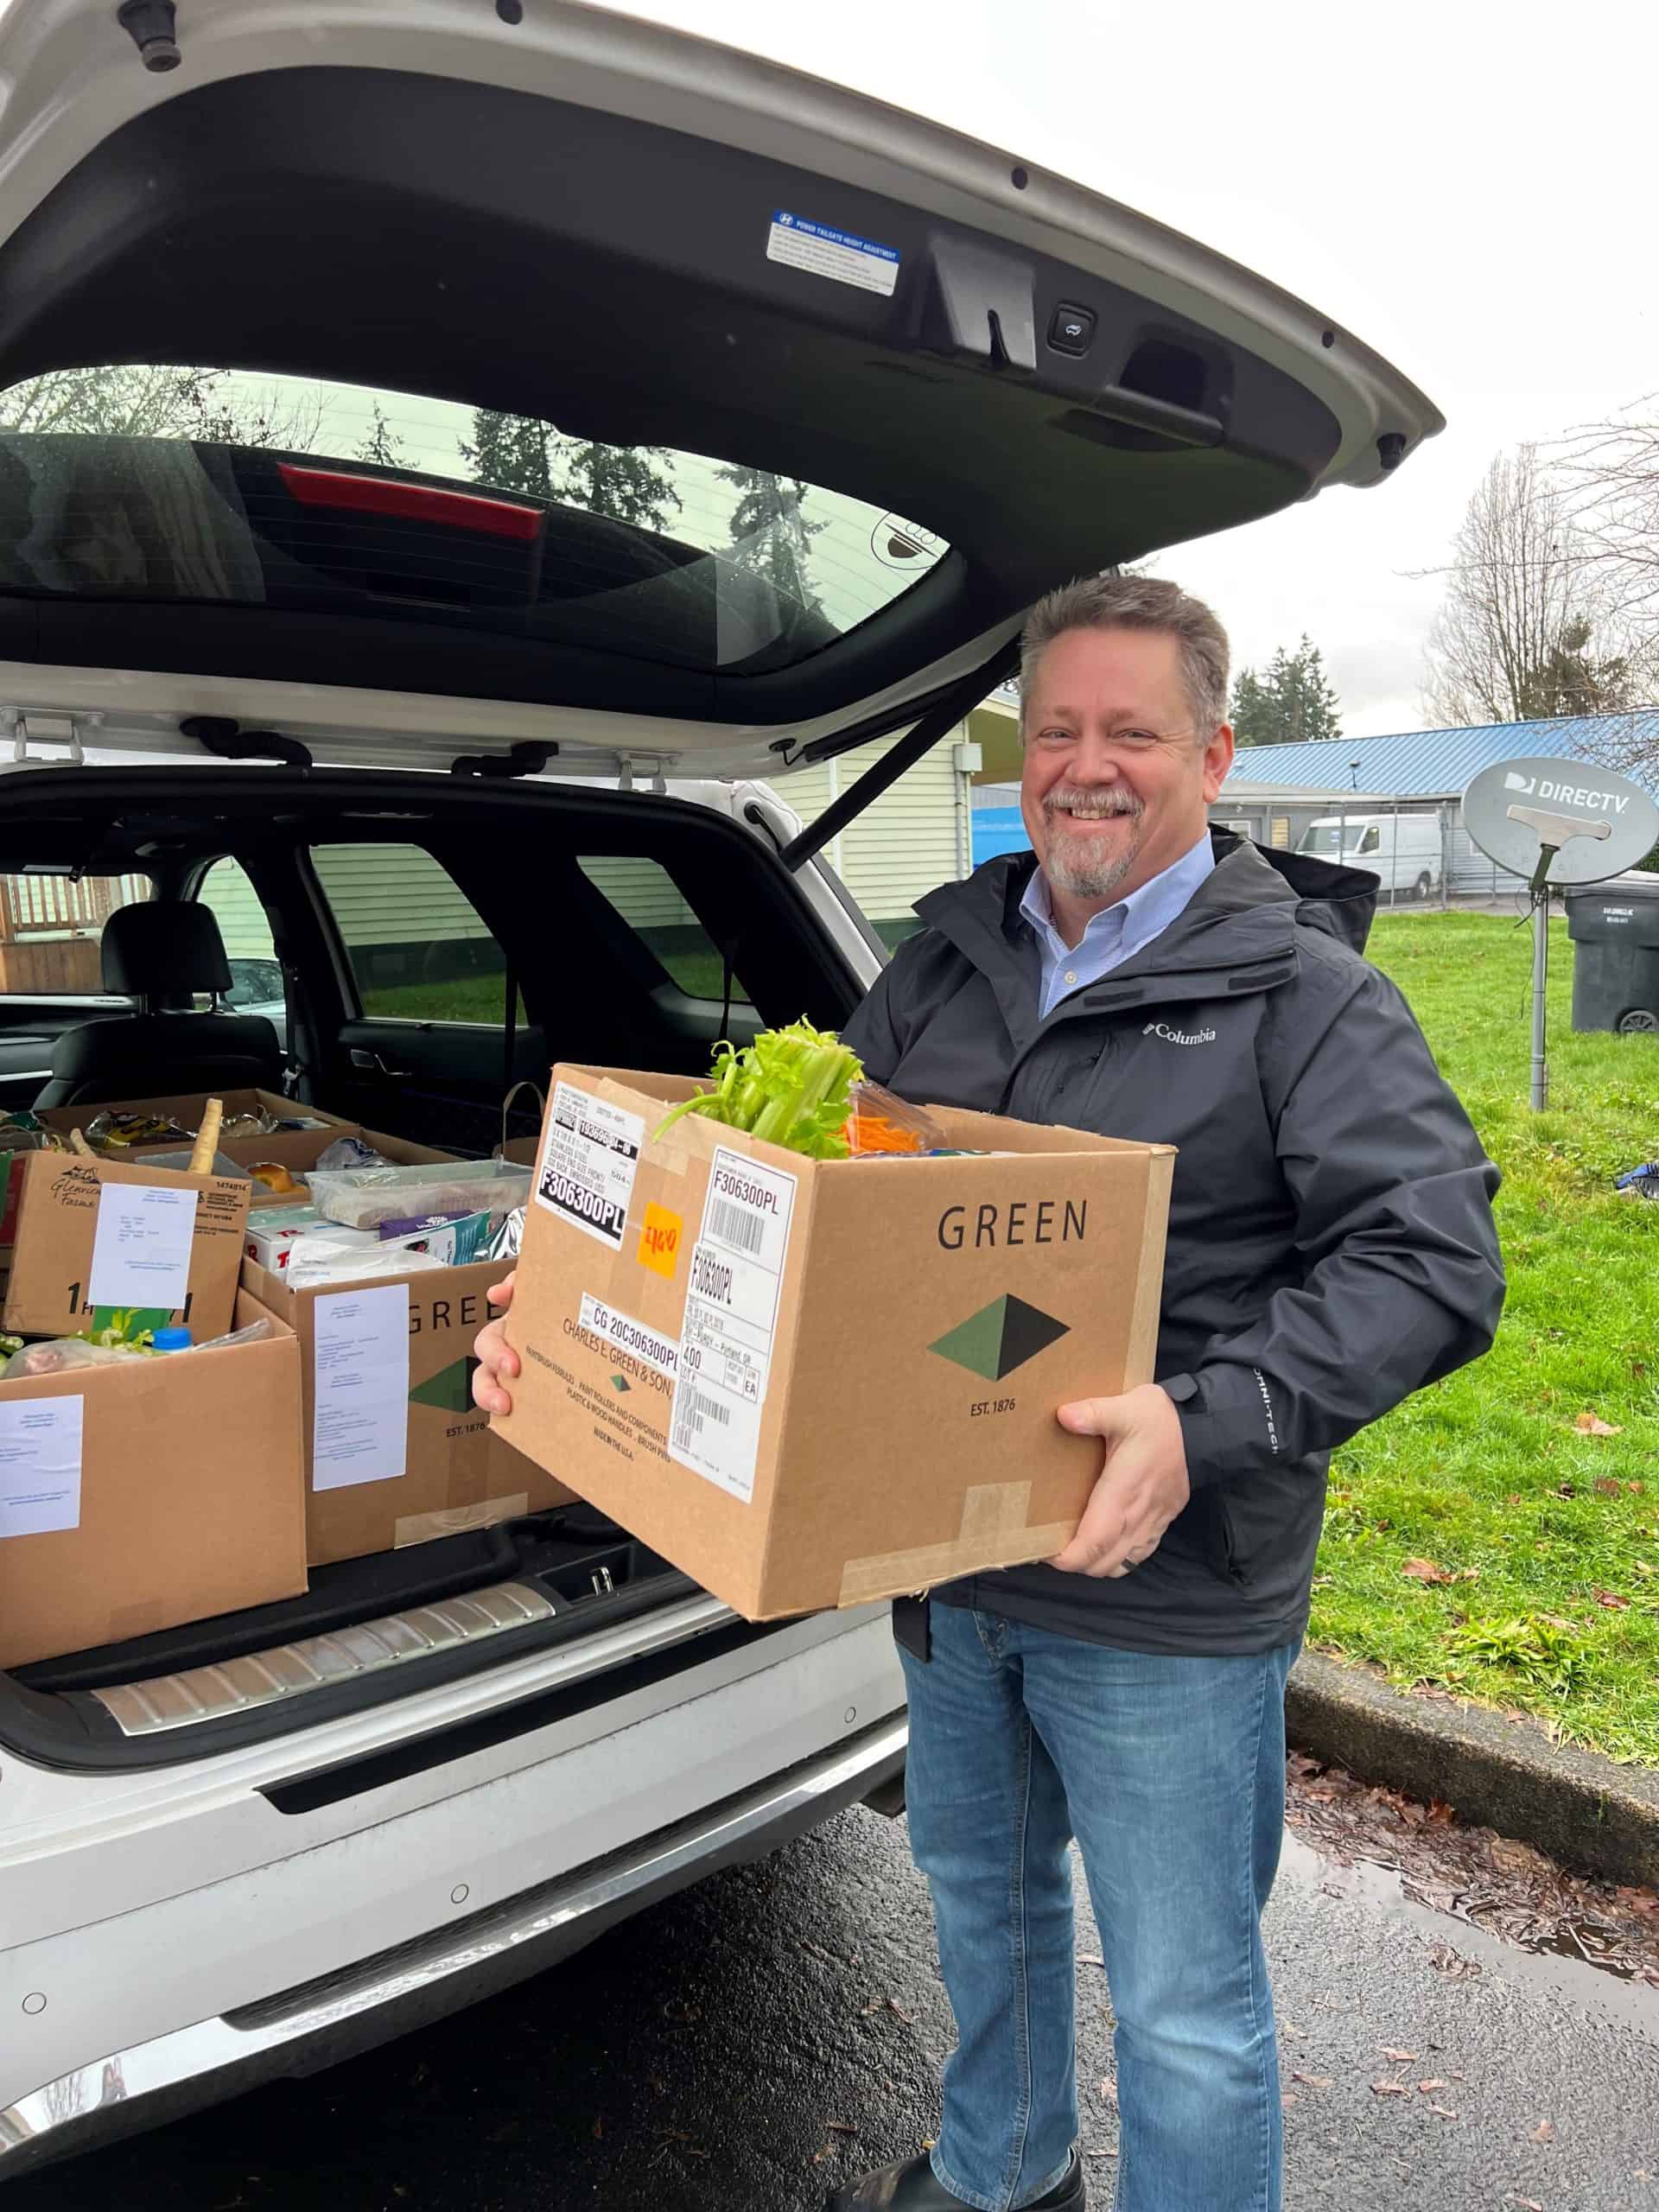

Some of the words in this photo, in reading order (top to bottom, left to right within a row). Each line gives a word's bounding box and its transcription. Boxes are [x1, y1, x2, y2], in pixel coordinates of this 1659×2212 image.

[1538, 780, 1630, 814] DIRECTV
[1155, 1023, 1216, 1045] Columbia
[541, 1168, 623, 1233] F306300PL
[714, 1169, 779, 1216] F306300PL
[938, 1199, 1087, 1250] GREEN
[691, 1253, 734, 1306] F306300PL
[409, 1295, 504, 1335] GREE
[594, 1307, 607, 1328] CG
[563, 1318, 600, 1353] CHARLES
[609, 1347, 639, 1379] GREEN
[640, 1365, 648, 1382] &
[683, 1347, 702, 1370] 400
[745, 1381, 755, 1395] EA
[970, 1401, 990, 1417] EST.
[993, 1397, 1016, 1414] 1876
